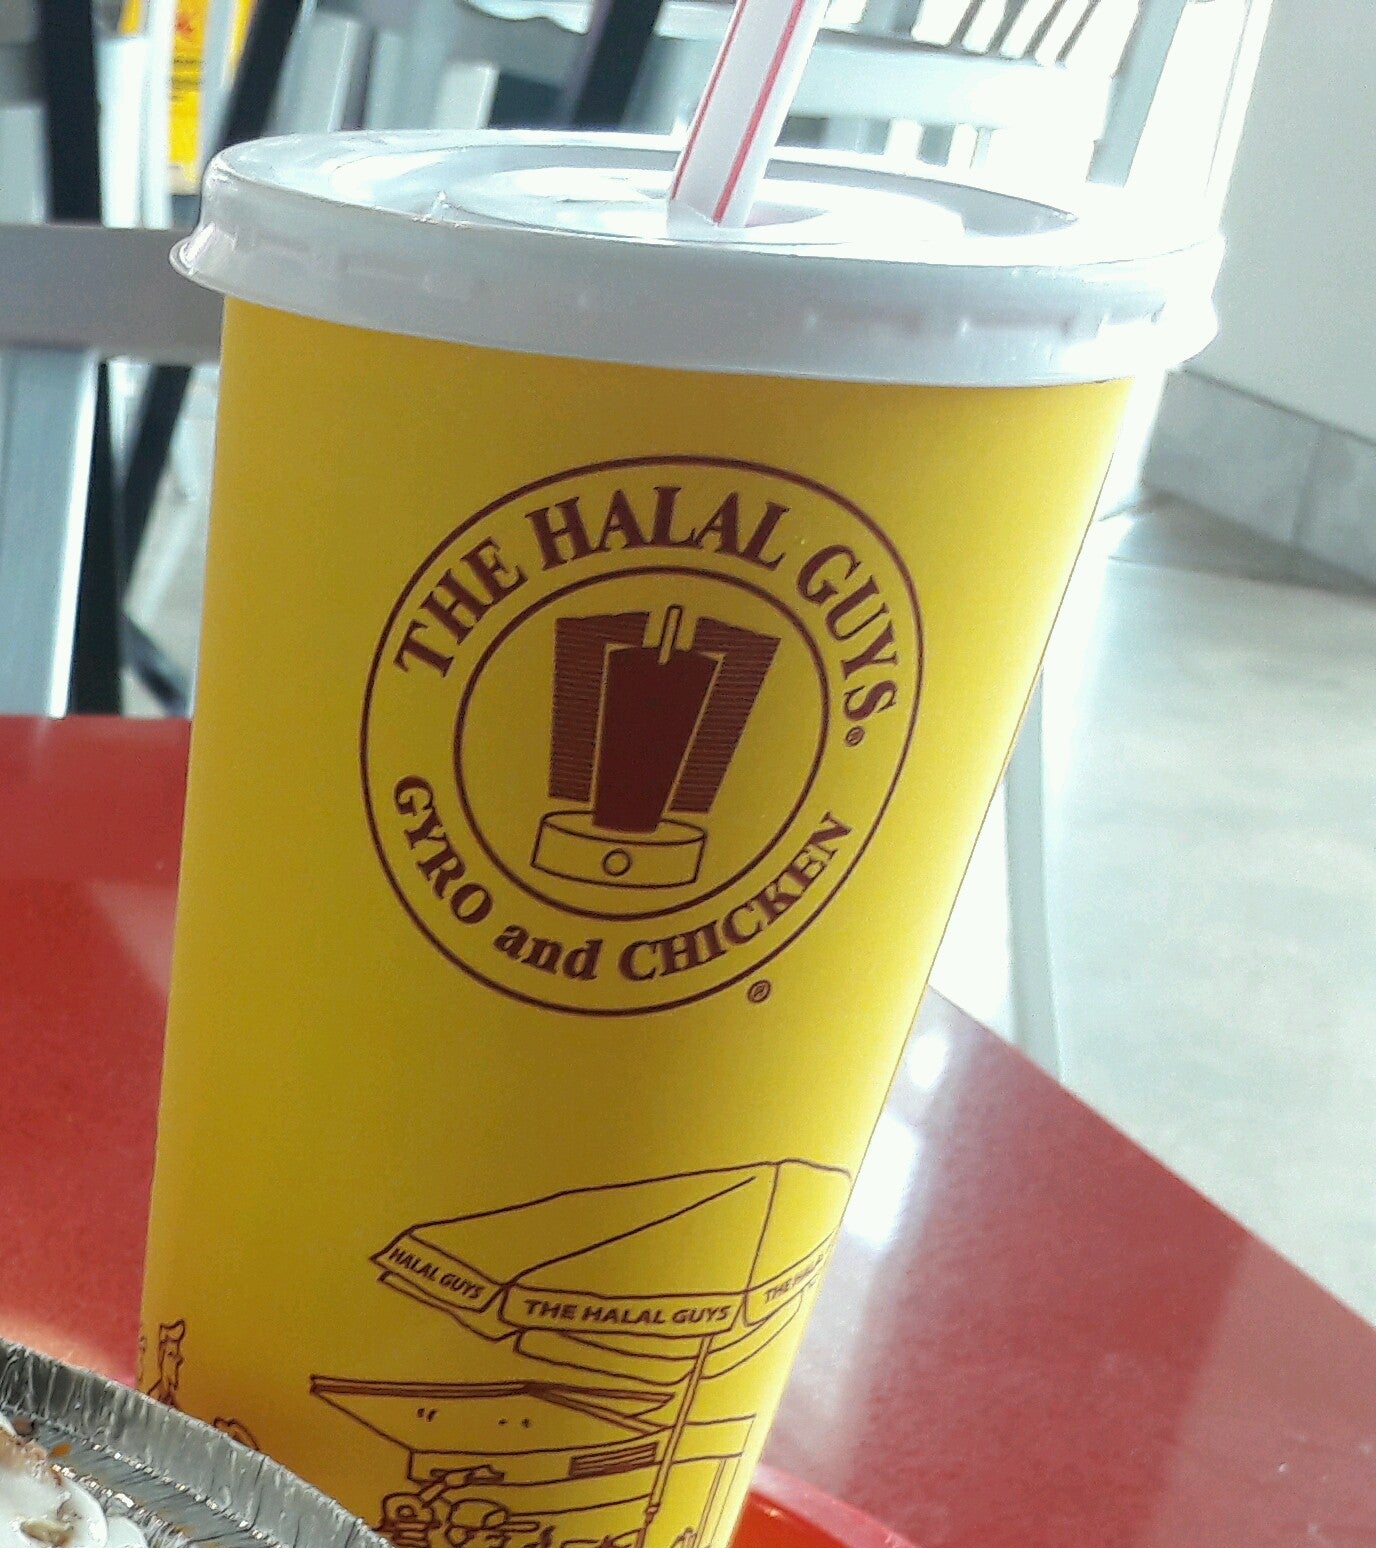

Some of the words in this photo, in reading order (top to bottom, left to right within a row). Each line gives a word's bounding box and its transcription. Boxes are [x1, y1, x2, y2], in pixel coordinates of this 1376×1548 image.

[395, 536, 527, 677] THE
[524, 486, 790, 572] HALAL
[394, 775, 493, 925] GYRO
[494, 923, 602, 981] and
[618, 811, 852, 981] CHICKEN
[388, 1246, 439, 1281] HALAL
[439, 1272, 483, 1300] GUYS
[523, 1298, 574, 1321] THE
[581, 1300, 666, 1325] HALAL
[673, 1302, 732, 1325] GUYS
